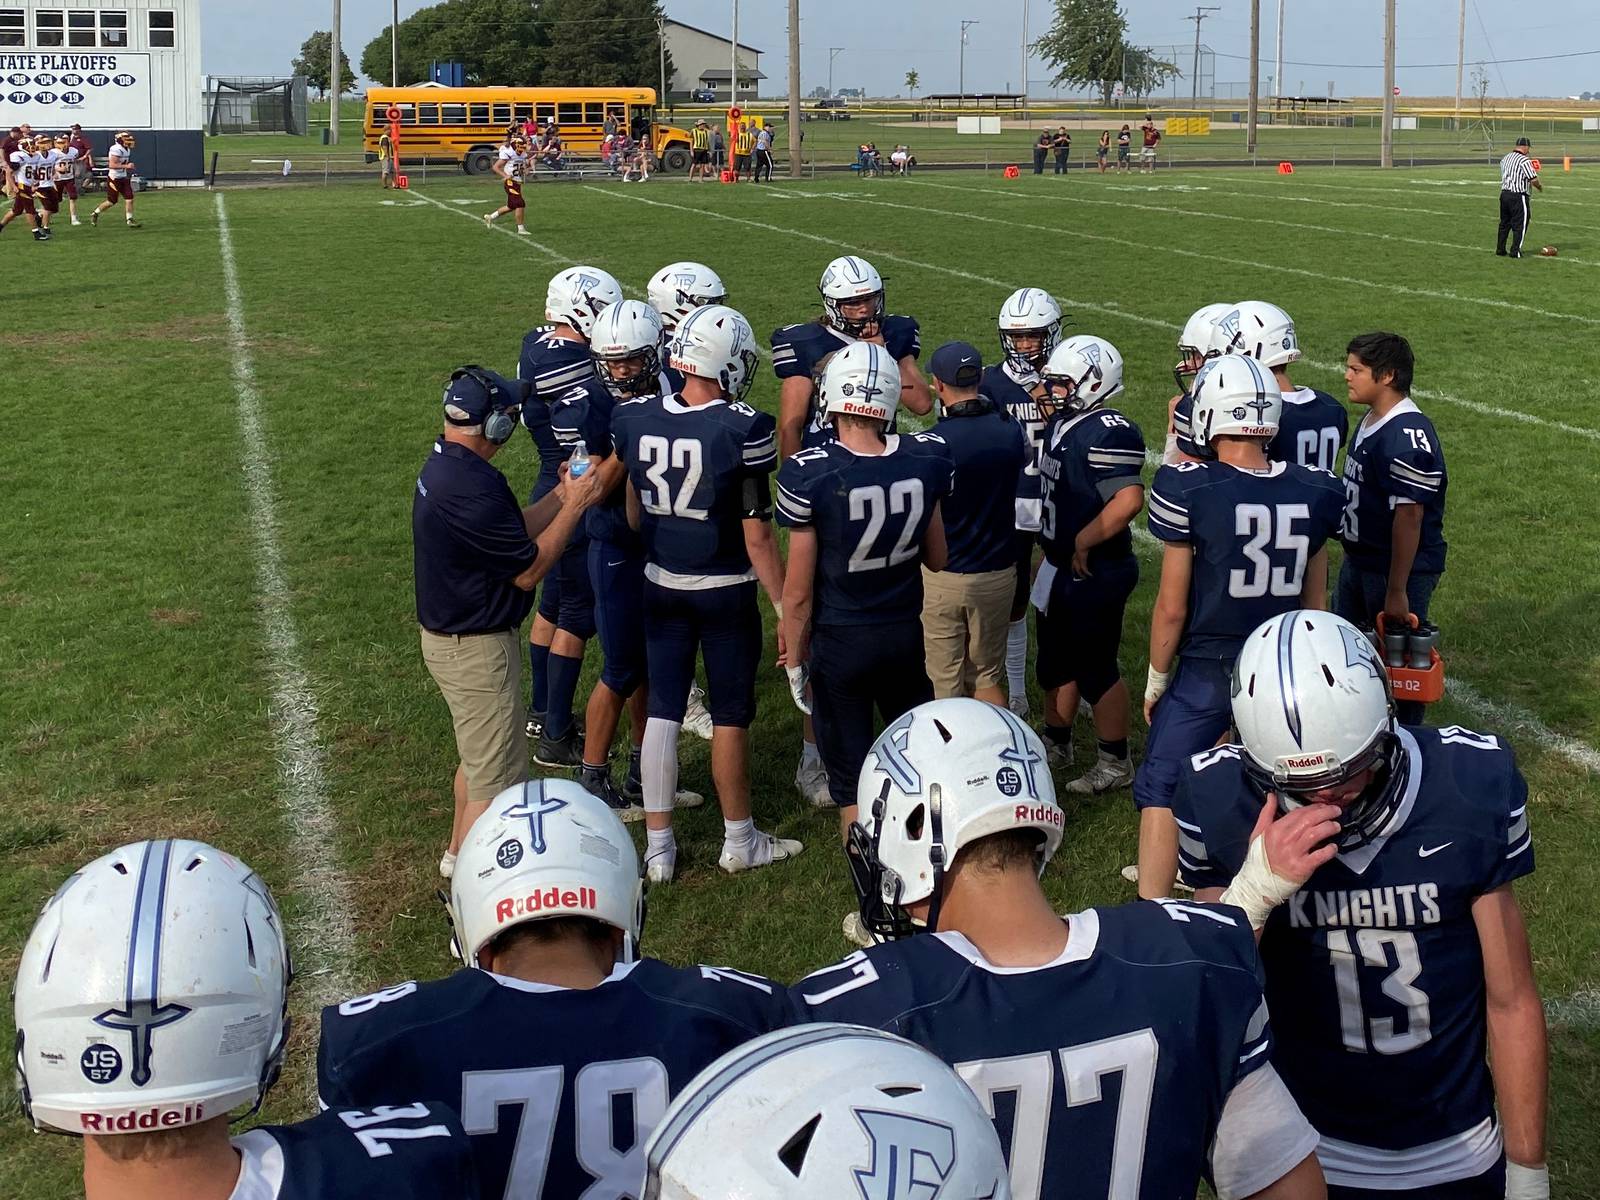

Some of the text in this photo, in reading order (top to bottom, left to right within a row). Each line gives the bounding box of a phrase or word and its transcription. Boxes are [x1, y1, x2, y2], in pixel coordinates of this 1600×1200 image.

[40, 55, 117, 70] PLAYOFFS
[670, 357, 697, 374] ddell
[843, 402, 886, 418] Riddell
[1100, 414, 1130, 429] 65
[1402, 427, 1433, 454] 73
[638, 434, 709, 522] 32
[847, 477, 925, 574] 22
[1228, 503, 1311, 599] 35
[1287, 755, 1324, 768] Riddell
[998, 771, 1019, 785] JS
[1004, 785, 1017, 793] 57
[498, 841, 520, 860] JS
[496, 887, 596, 924] Riddell
[1289, 882, 1441, 928] KNIGHTS
[1327, 929, 1433, 1056] 13
[83, 1050, 117, 1068] JS
[91, 1068, 112, 1080] 57
[80, 1103, 203, 1132] Riddell
[953, 1026, 1160, 1200] 77
[460, 1056, 670, 1200] 78
